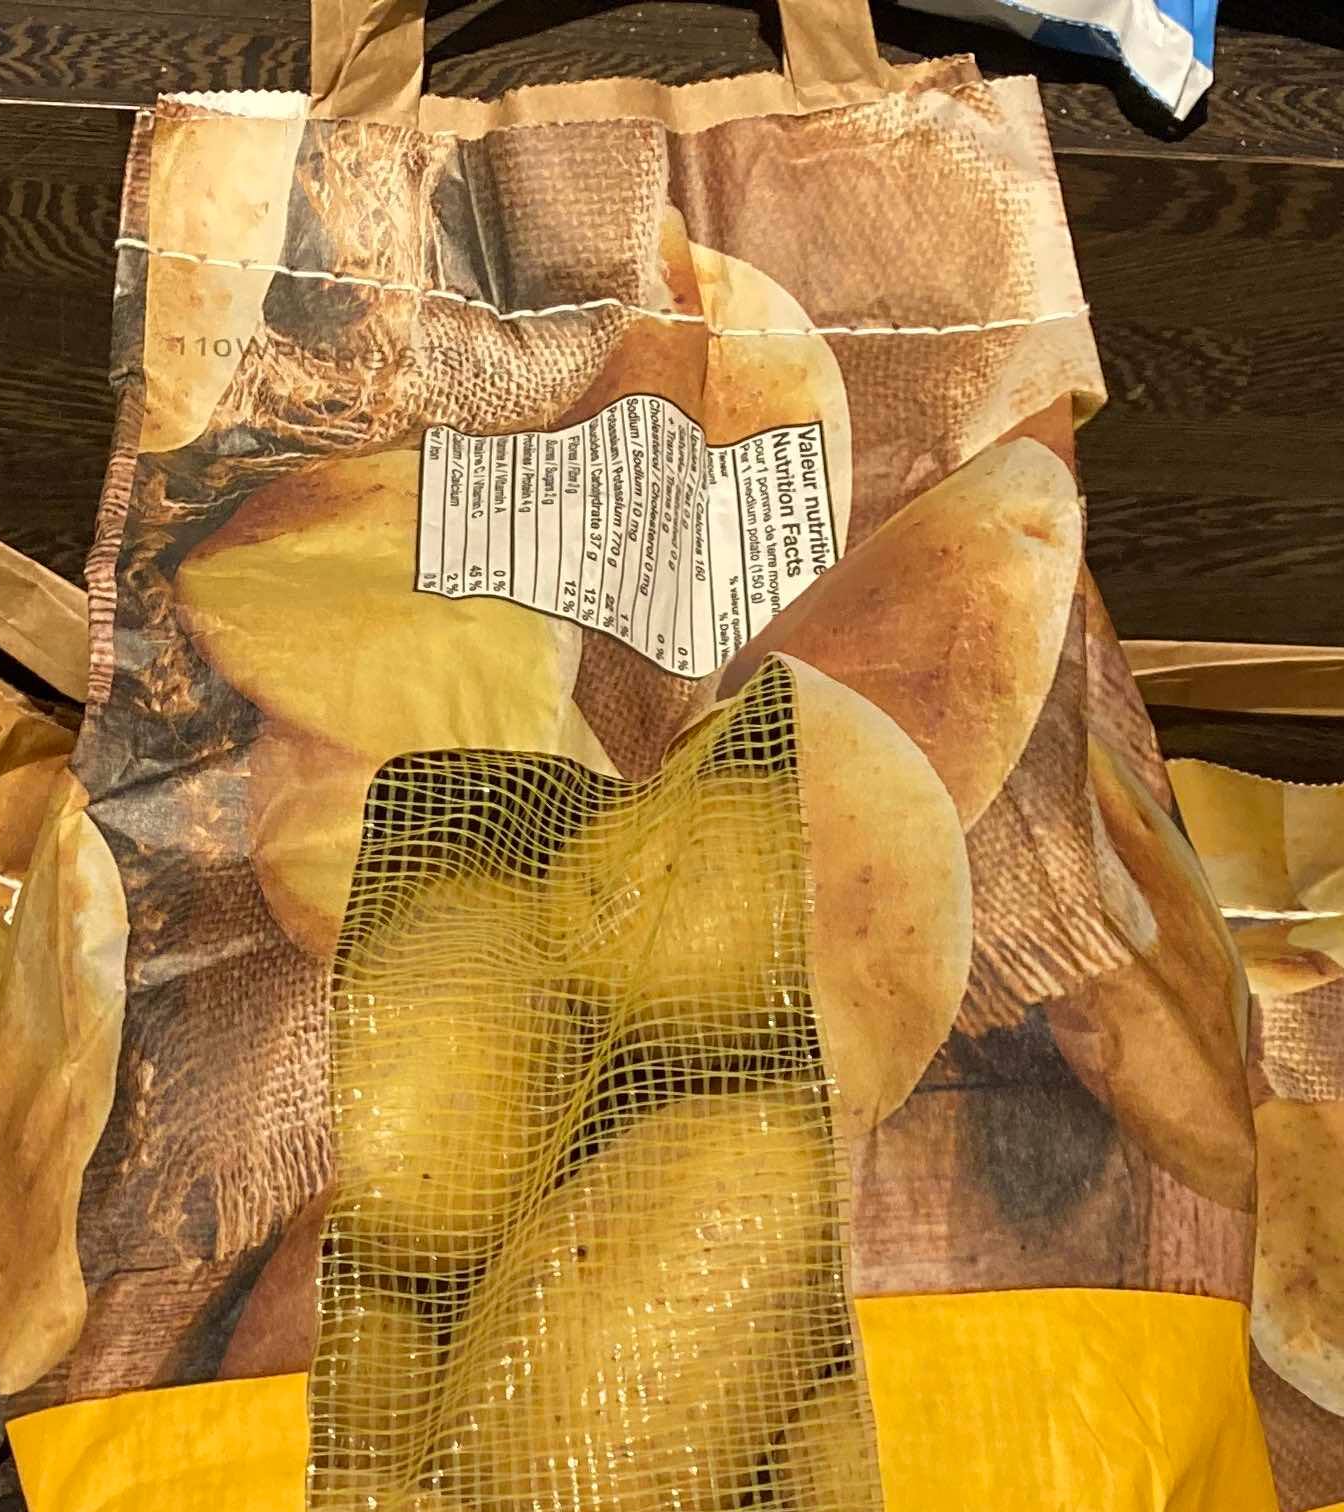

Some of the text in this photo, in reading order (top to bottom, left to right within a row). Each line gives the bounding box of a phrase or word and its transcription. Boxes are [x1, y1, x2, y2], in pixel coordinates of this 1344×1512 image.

[747, 528, 762, 561] potato
[765, 525, 777, 541] de
[772, 431, 803, 578] Nutrition Facts
[798, 428, 830, 576] Valeur nutritive
